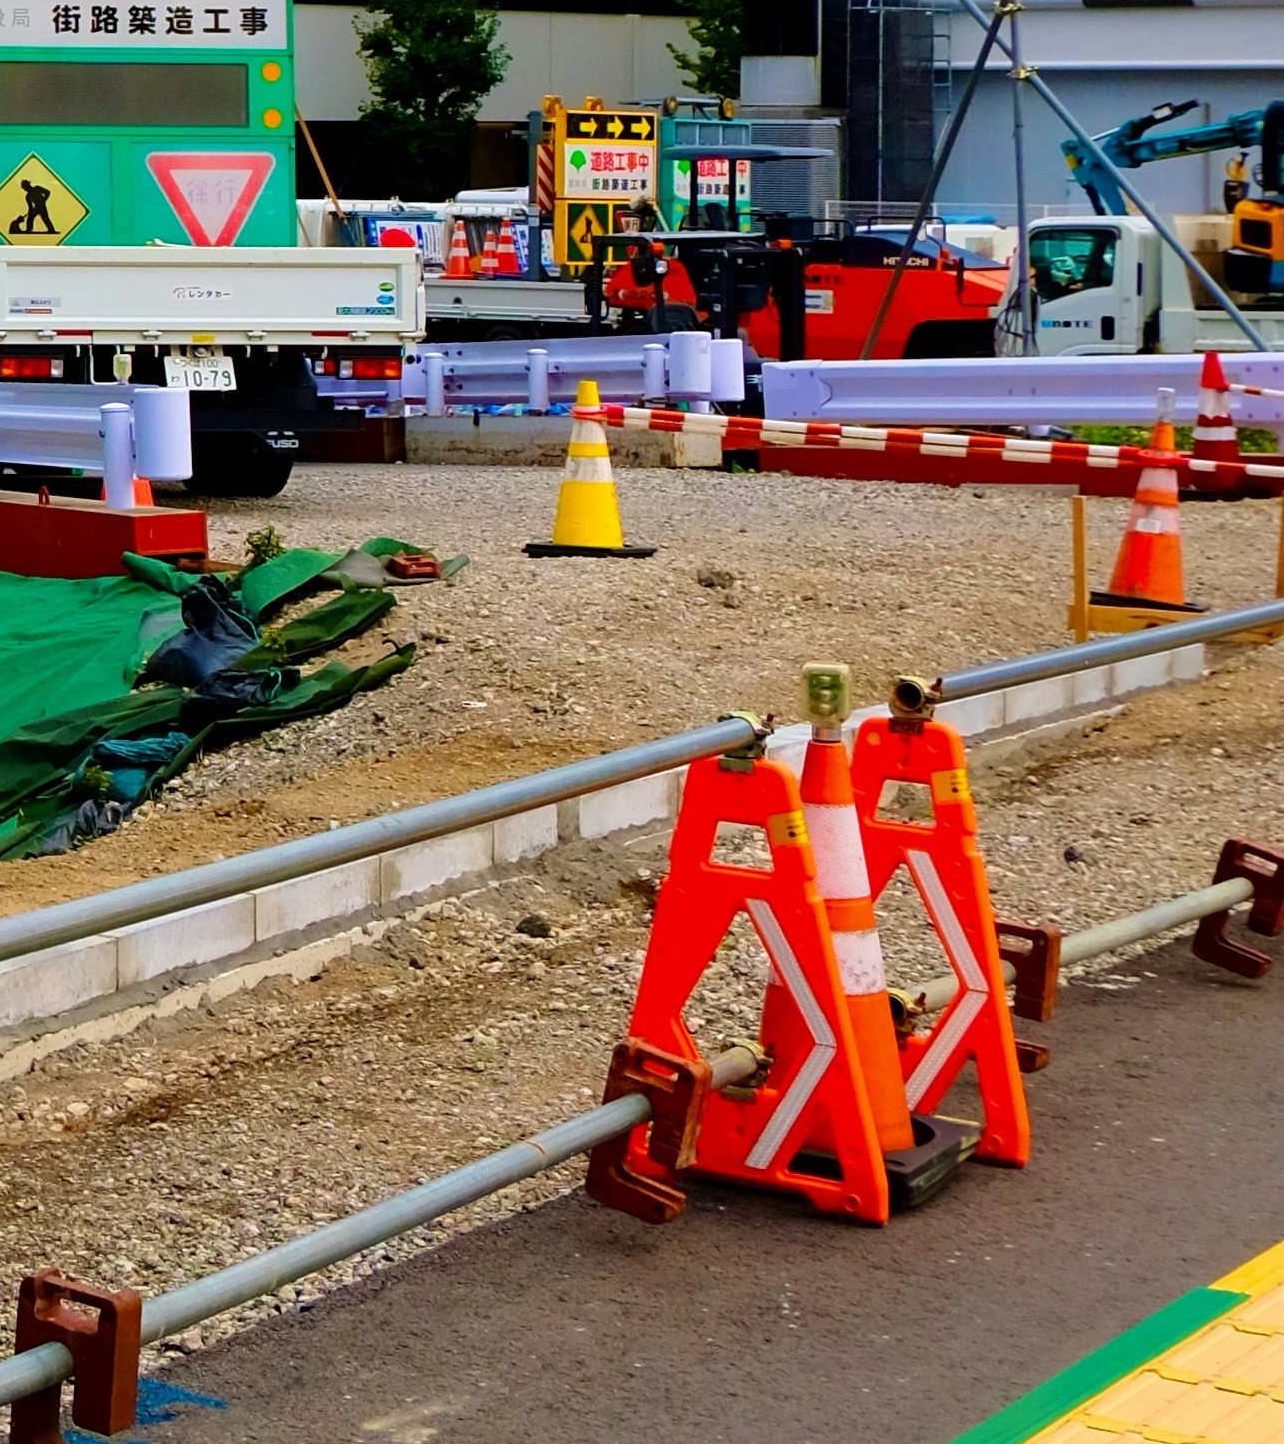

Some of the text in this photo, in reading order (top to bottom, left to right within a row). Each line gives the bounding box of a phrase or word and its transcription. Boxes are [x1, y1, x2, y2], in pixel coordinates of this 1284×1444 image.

[52, 4, 269, 36] 街路築造工事
[590, 150, 649, 173] 道路工事中
[187, 179, 237, 205] 徐行
[592, 178, 648, 191] 街路築造工事
[183, 370, 231, 387] 10-79
